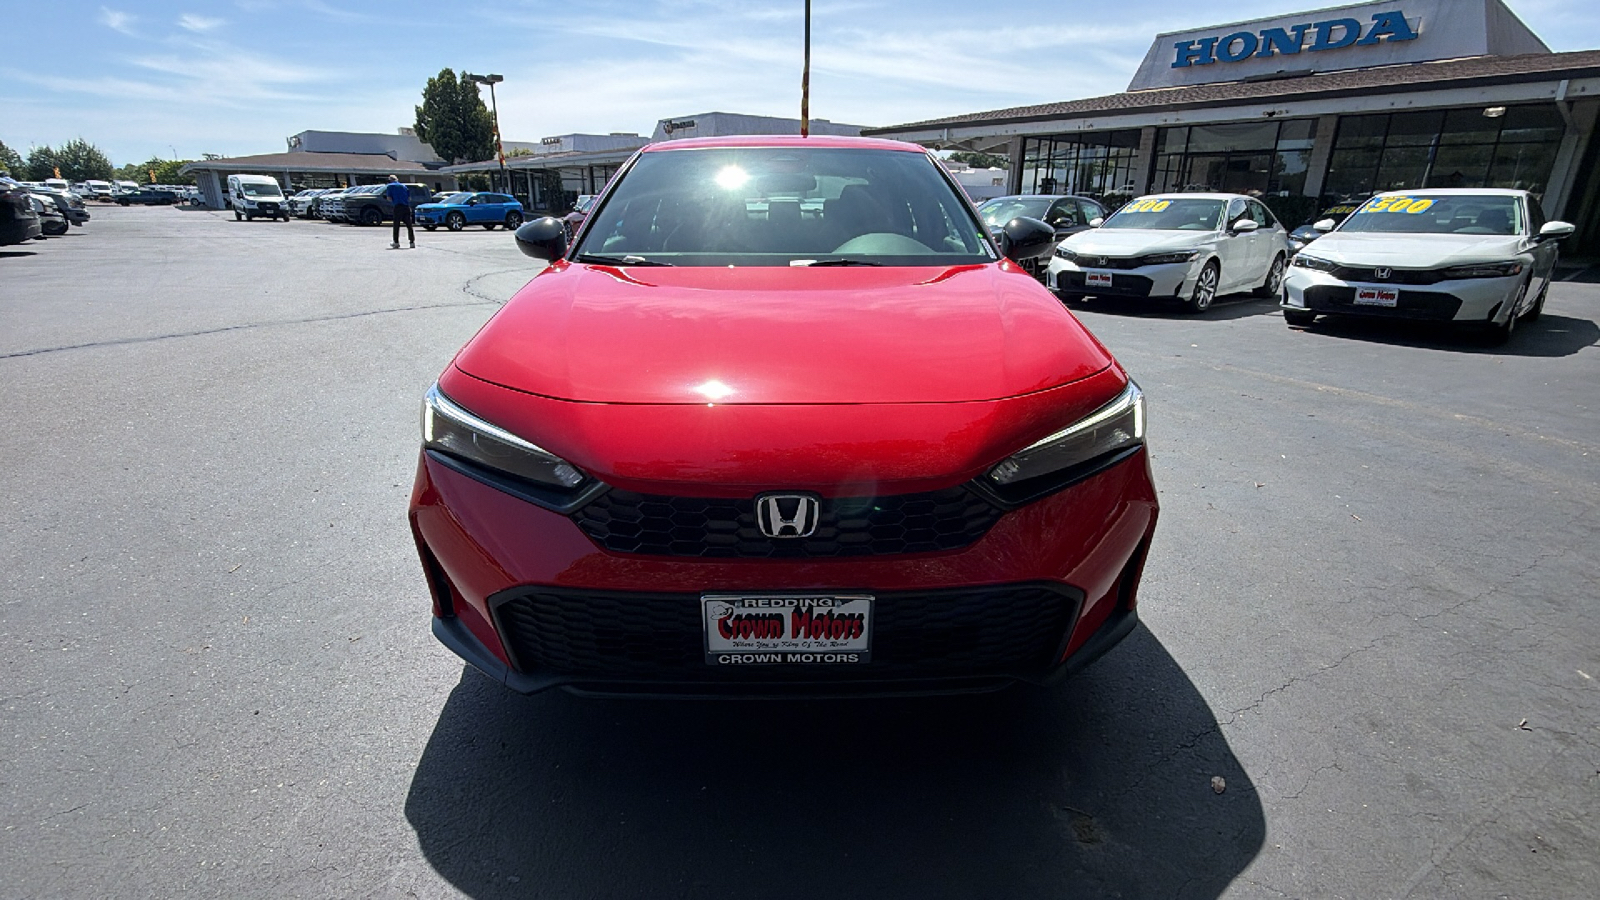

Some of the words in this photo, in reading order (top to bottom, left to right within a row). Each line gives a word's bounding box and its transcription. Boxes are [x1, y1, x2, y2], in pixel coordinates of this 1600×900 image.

[1171, 10, 1419, 69] HONDA
[744, 598, 833, 608] REDDING
[718, 612, 785, 640] Crown
[791, 606, 865, 640] Motors
[718, 654, 782, 665] CROWN
[787, 653, 860, 663] MOTORS
